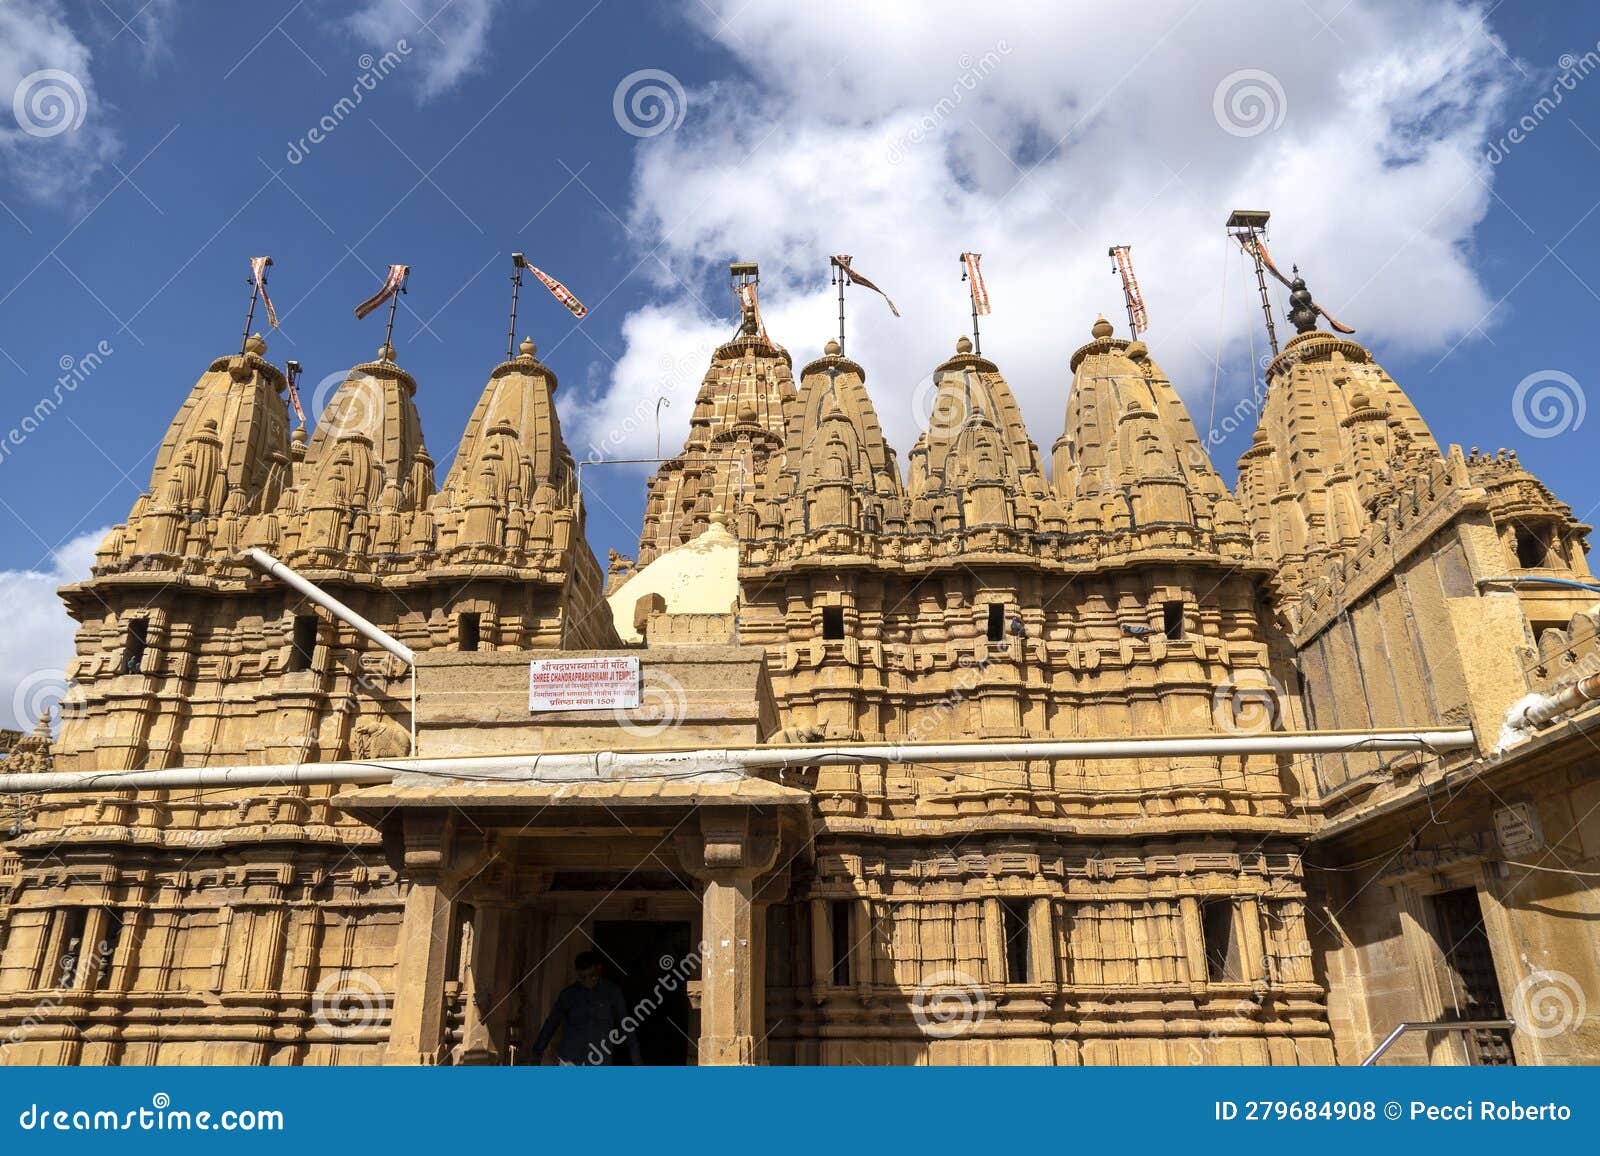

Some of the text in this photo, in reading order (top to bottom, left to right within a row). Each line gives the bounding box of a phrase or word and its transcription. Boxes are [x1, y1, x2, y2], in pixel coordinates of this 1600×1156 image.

[533, 672, 550, 683] SHREE
[609, 671, 614, 680] JI
[616, 670, 636, 680] TEMPLE
